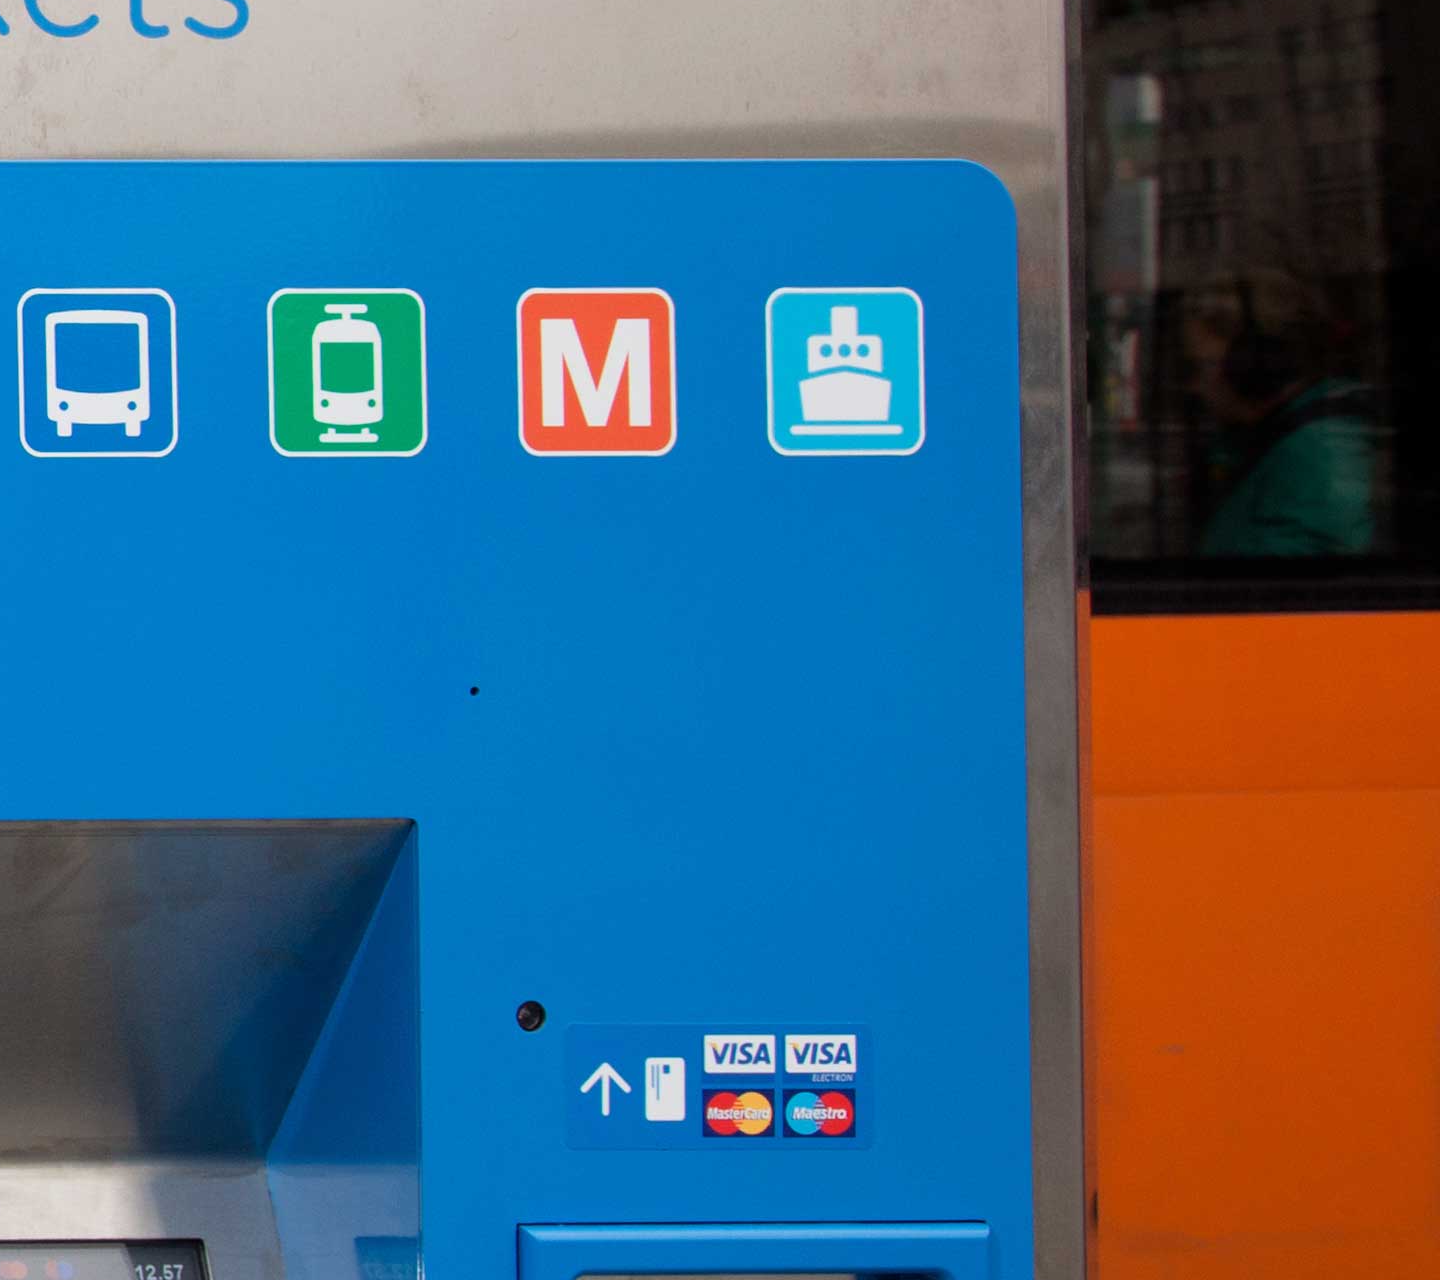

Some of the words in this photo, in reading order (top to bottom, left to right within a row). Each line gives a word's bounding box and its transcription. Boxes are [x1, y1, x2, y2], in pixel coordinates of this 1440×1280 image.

[541, 318, 652, 428] M
[710, 1042, 771, 1064] VISA
[790, 1042, 852, 1064] VISA
[812, 1073, 853, 1082] ELECTRON
[707, 1107, 771, 1120] MasterCard
[793, 1107, 848, 1120] Maestro
[134, 1264, 183, 1280] 12.57
